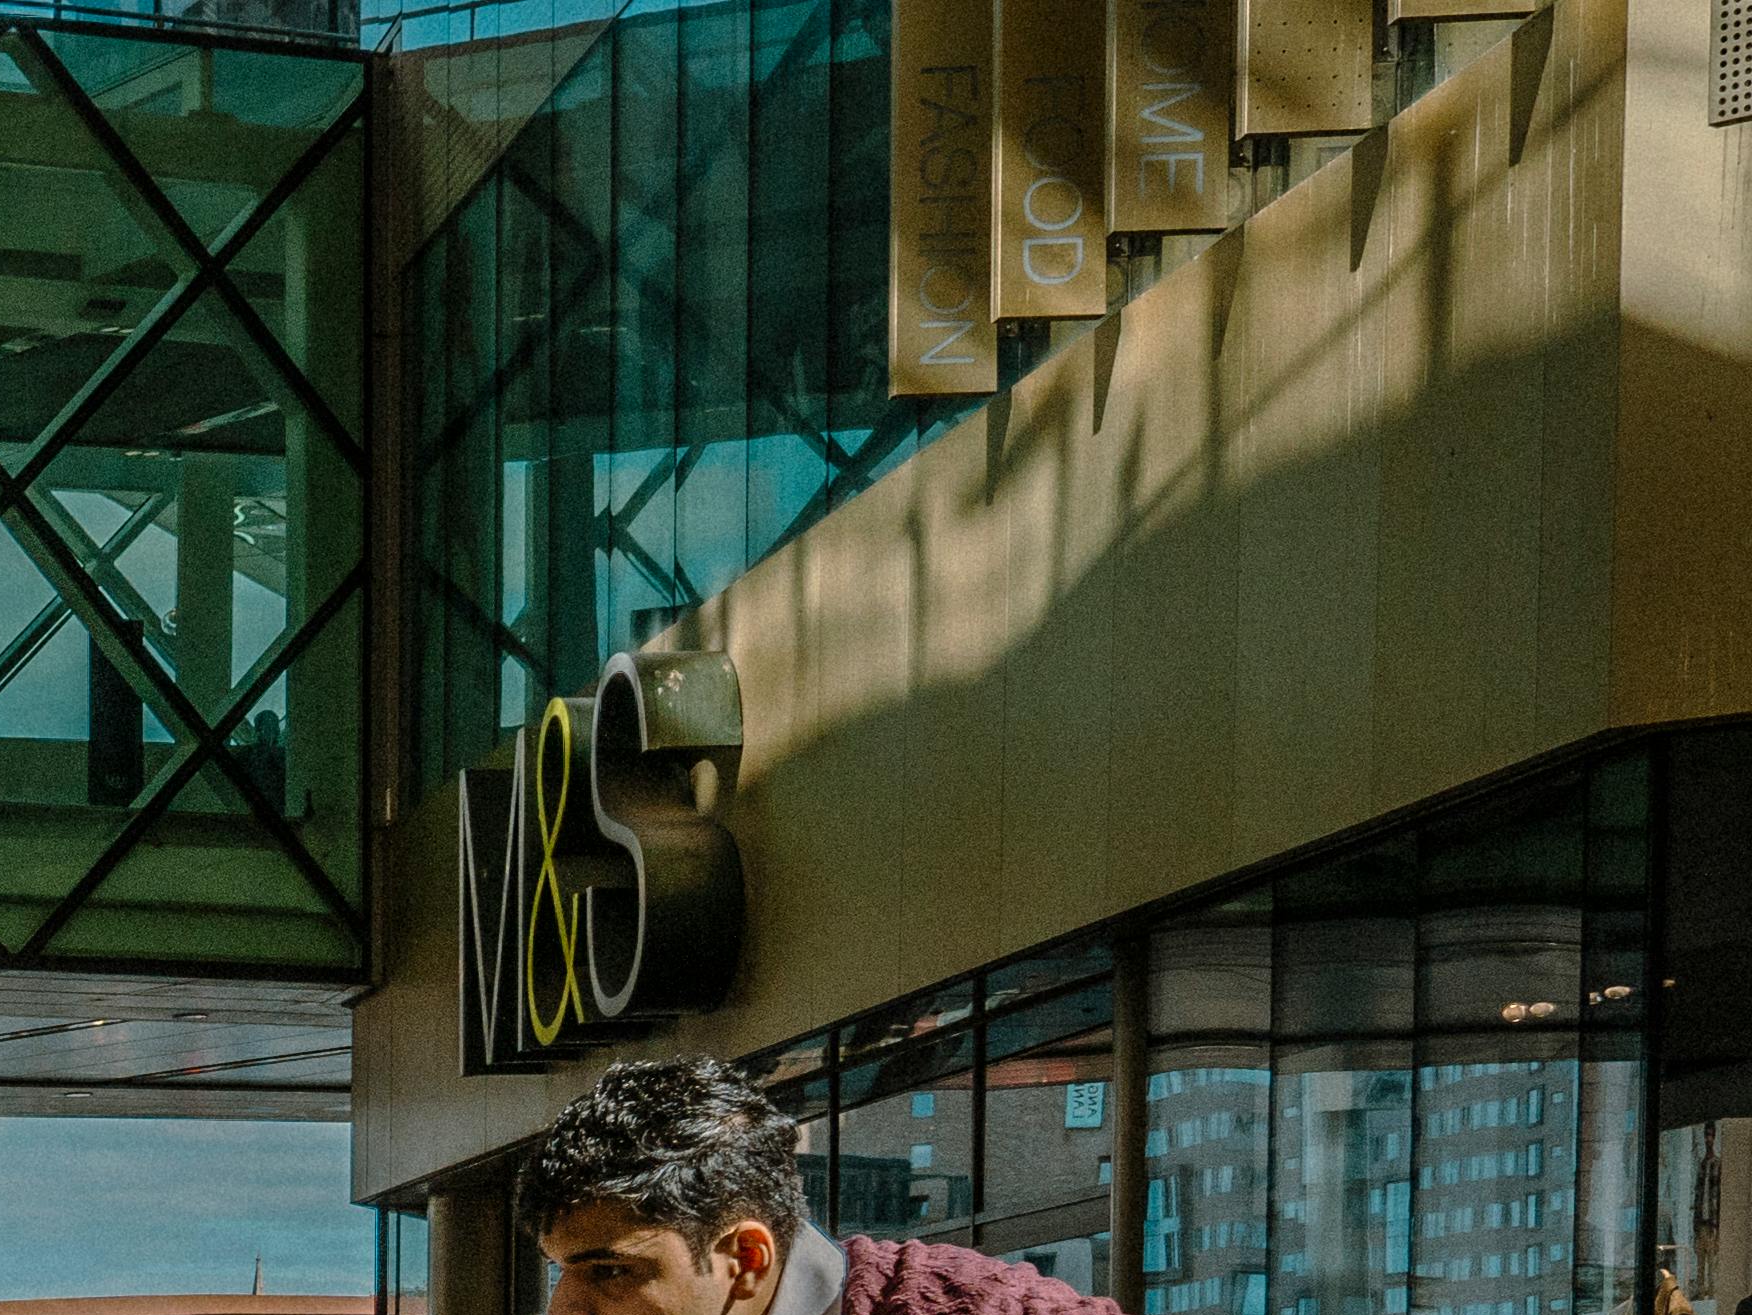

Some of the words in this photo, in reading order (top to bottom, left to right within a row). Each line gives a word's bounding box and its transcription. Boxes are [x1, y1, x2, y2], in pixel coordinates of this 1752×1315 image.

[918, 64, 979, 365] FASHION
[1022, 75, 1085, 285] FOOD
[1137, 0, 1204, 198] OME
[459, 652, 704, 1076] M&S
